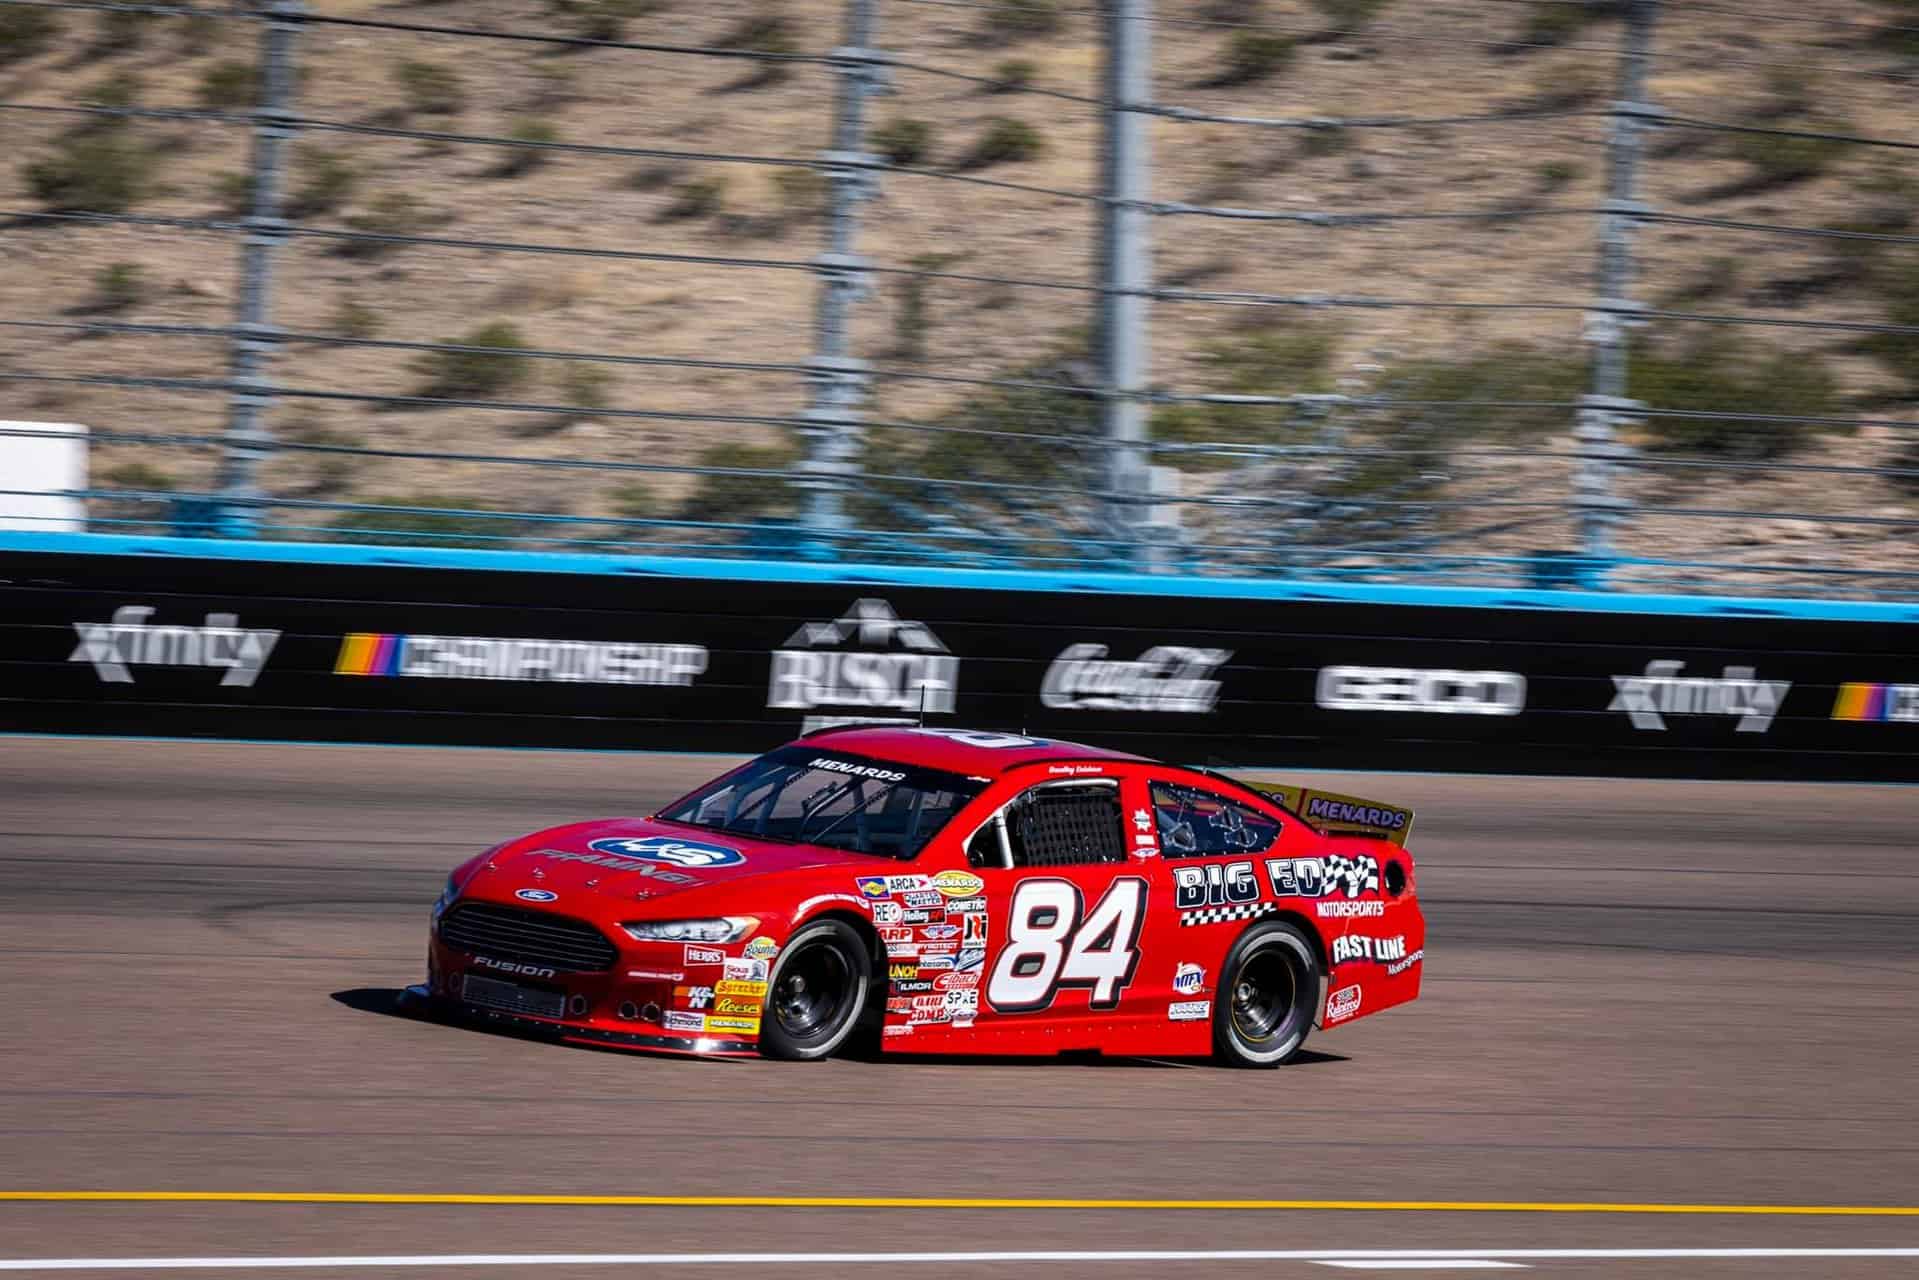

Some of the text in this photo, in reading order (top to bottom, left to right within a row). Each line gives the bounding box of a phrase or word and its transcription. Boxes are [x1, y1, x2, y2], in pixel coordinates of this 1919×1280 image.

[766, 650, 961, 714] BUSCH
[1316, 666, 1527, 716] GEICO
[809, 759, 907, 786] MENARDS
[1309, 798, 1406, 829] MENARDS
[890, 877, 917, 890] ARCA
[1174, 856, 1324, 909] BIG ED
[1316, 900, 1385, 917] MOTORSPORTS
[985, 876, 1149, 1014] 84
[1332, 935, 1406, 964] FAST LINE
[473, 956, 556, 979] FUSION
[888, 964, 918, 978] UNOH
[716, 998, 759, 1012] Reese
